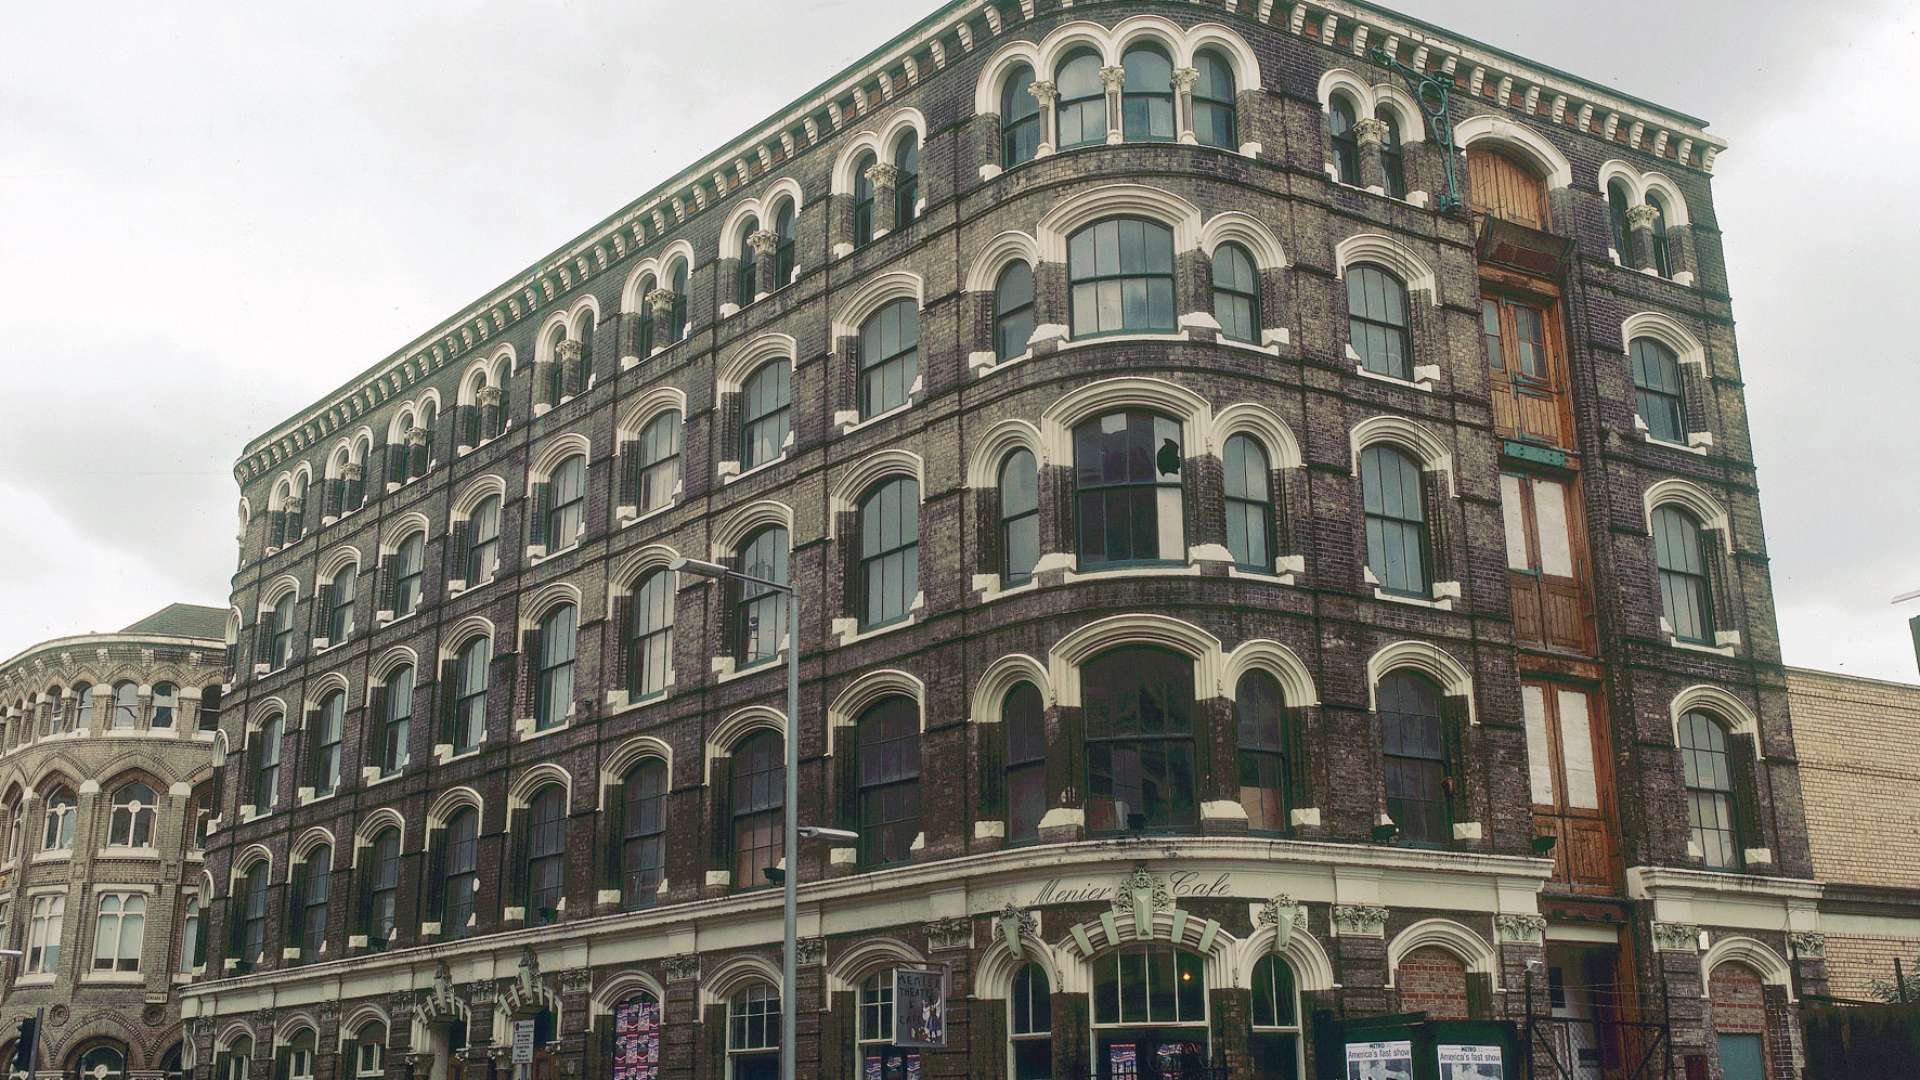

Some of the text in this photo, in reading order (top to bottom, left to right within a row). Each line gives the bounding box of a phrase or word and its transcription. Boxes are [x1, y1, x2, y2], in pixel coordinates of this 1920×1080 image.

[1029, 870, 1231, 904] Menier Cafe
[1348, 1049, 1378, 1059] America's
[1393, 1048, 1410, 1057] show
[1440, 1052, 1470, 1062] America's
[1484, 1053, 1501, 1062] show
